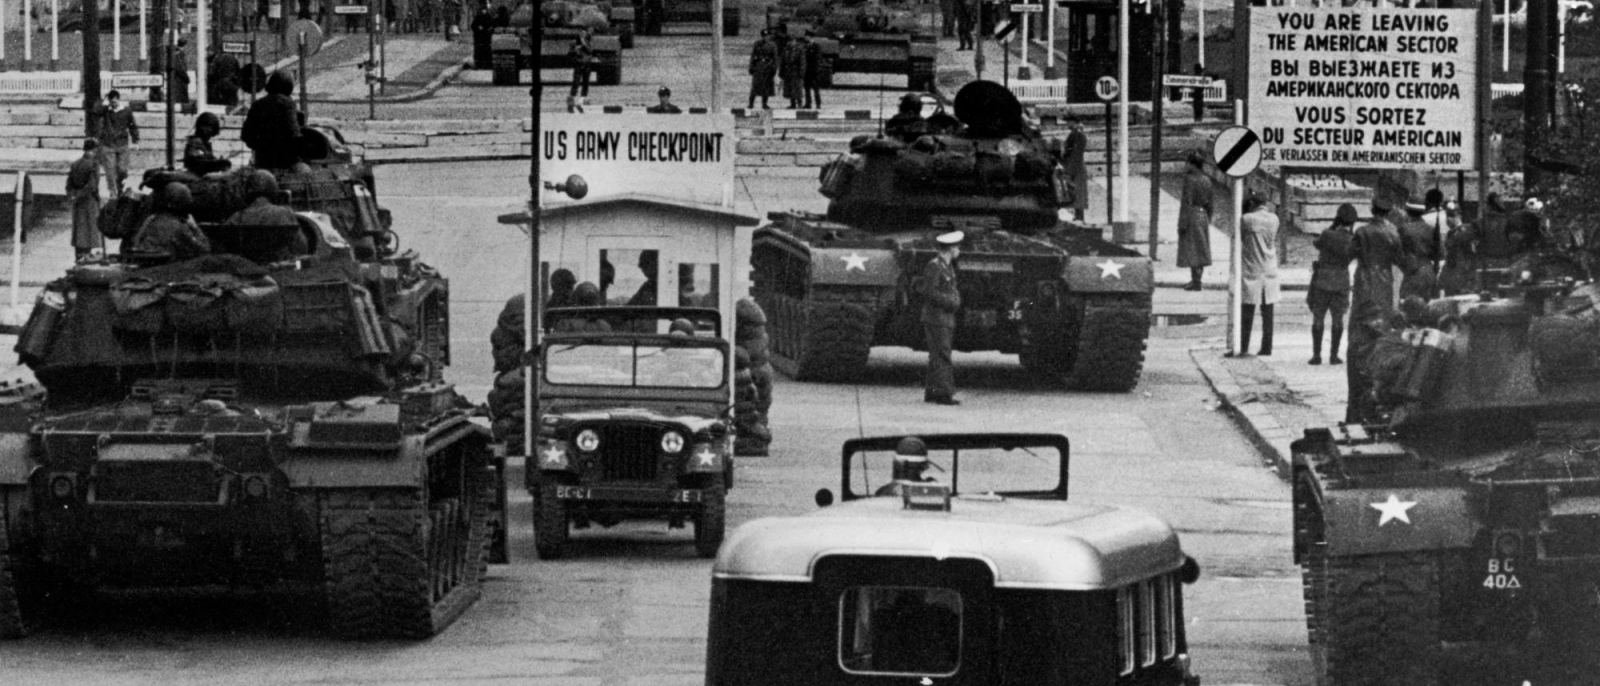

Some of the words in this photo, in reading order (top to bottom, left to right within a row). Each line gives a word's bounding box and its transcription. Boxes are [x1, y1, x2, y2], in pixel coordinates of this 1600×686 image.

[1278, 13, 1314, 30] YOU
[1324, 14, 1361, 31] ARE
[1372, 15, 1448, 32] LEAVING
[1268, 34, 1296, 50] THE
[1304, 34, 1387, 52] AMERICAN
[1397, 36, 1458, 53] SECTOR
[1271, 59, 1298, 76] ВЫ
[1309, 60, 1420, 78] ВЫЕЗЖАЕТЕ
[1432, 62, 1455, 79] ИЗ
[1100, 80, 1111, 96] 10
[1266, 81, 1389, 99] АМЕРИКАНСКОГО
[1396, 82, 1459, 99] СЕКТОРА
[1296, 106, 1345, 124] VOUS
[1356, 107, 1426, 125] SORTEZ
[545, 131, 567, 160] US
[576, 131, 620, 160] ARMY
[628, 132, 723, 162] CHECKPOINT
[1263, 127, 1284, 144] DU
[1294, 128, 1364, 145] SECTEUR
[1373, 130, 1461, 147] AMERICAIN
[1263, 149, 1277, 161] SIE
[1280, 149, 1328, 161] VERLASSEN
[1332, 150, 1348, 162] DEN
[1352, 151, 1425, 163] AMERIKANISCHEN
[1430, 153, 1460, 164] SEKTOR
